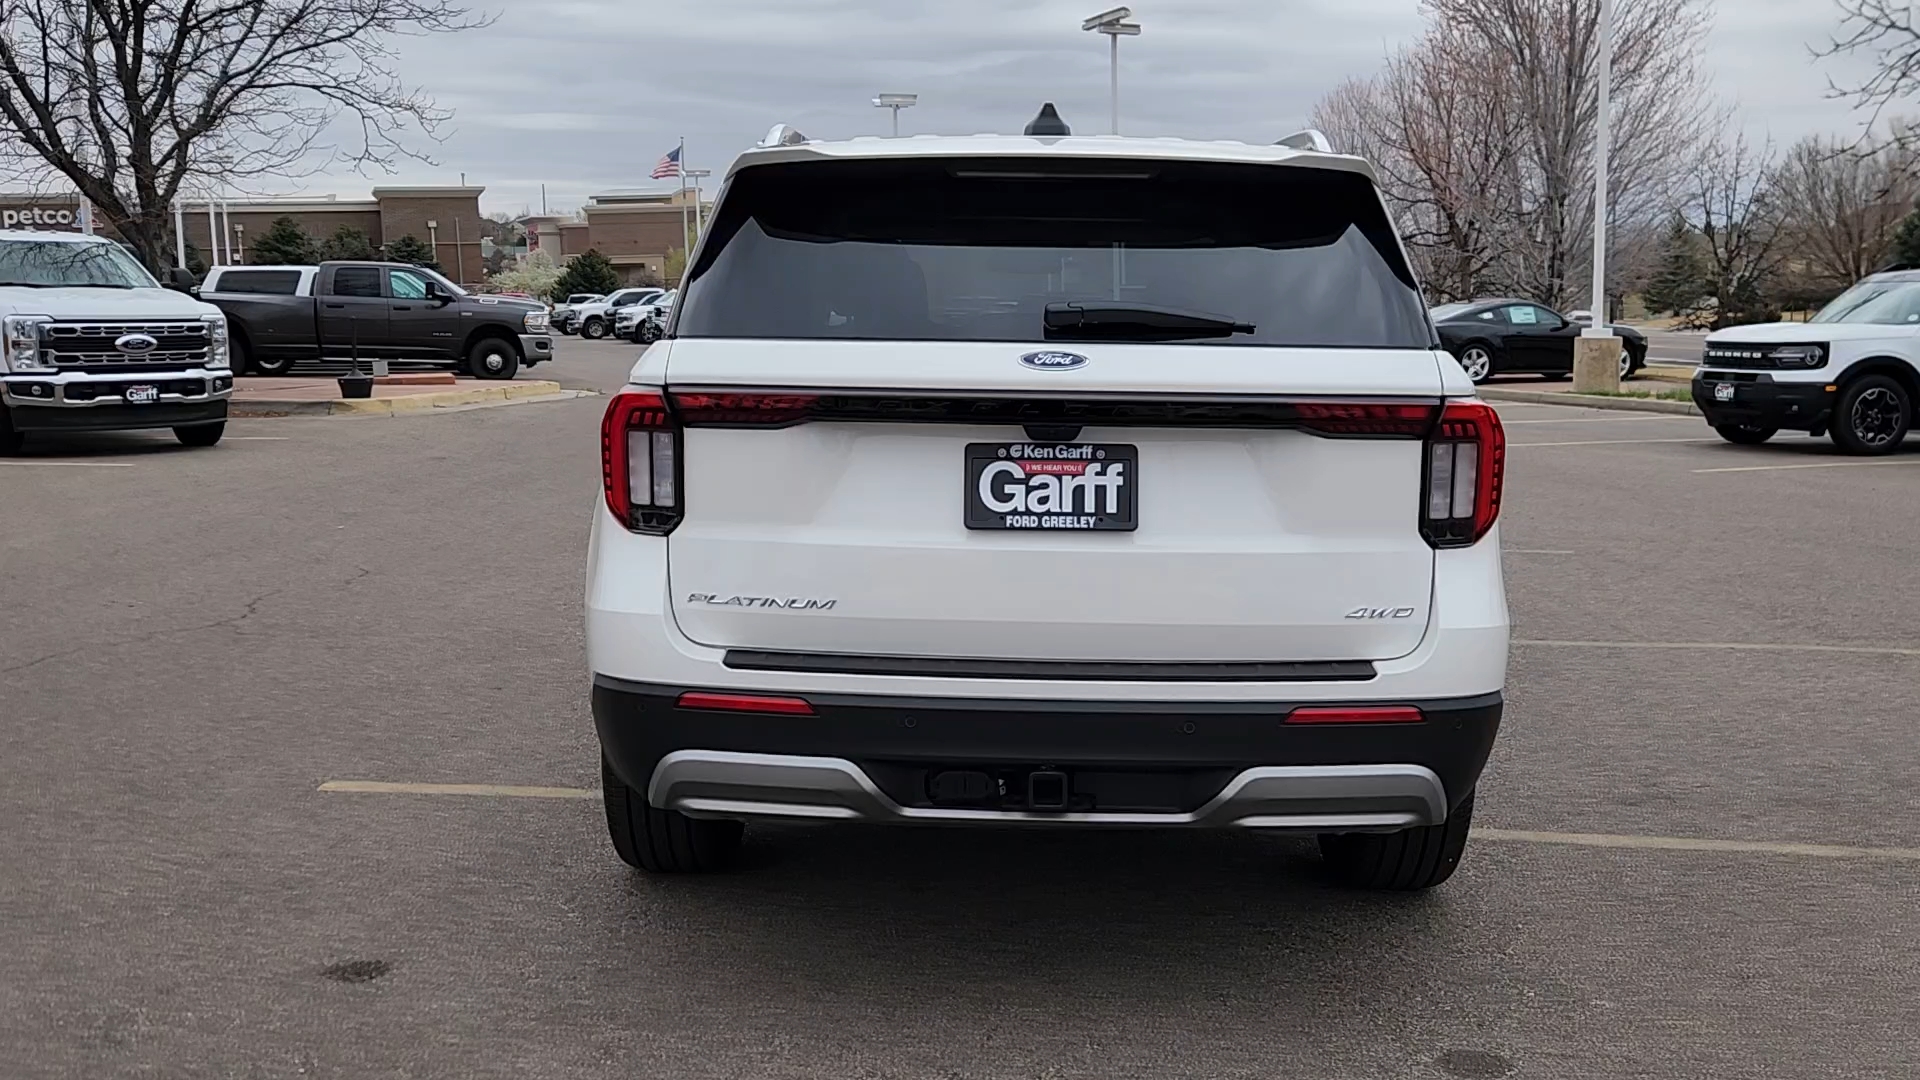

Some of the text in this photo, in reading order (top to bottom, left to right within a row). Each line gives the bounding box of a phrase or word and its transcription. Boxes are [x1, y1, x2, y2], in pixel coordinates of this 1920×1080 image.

[2, 207, 72, 228] petco
[1034, 353, 1073, 364] Ford
[126, 388, 158, 400] Garff
[1024, 444, 1054, 459] Ken
[1055, 445, 1093, 459] Garff
[1031, 464, 1077, 472] WE HEAR YOU
[978, 460, 1124, 514] Garff
[1005, 515, 1096, 529] FORD GREELEY
[687, 592, 838, 610] PLATINUM
[1344, 607, 1415, 619] 4WD
